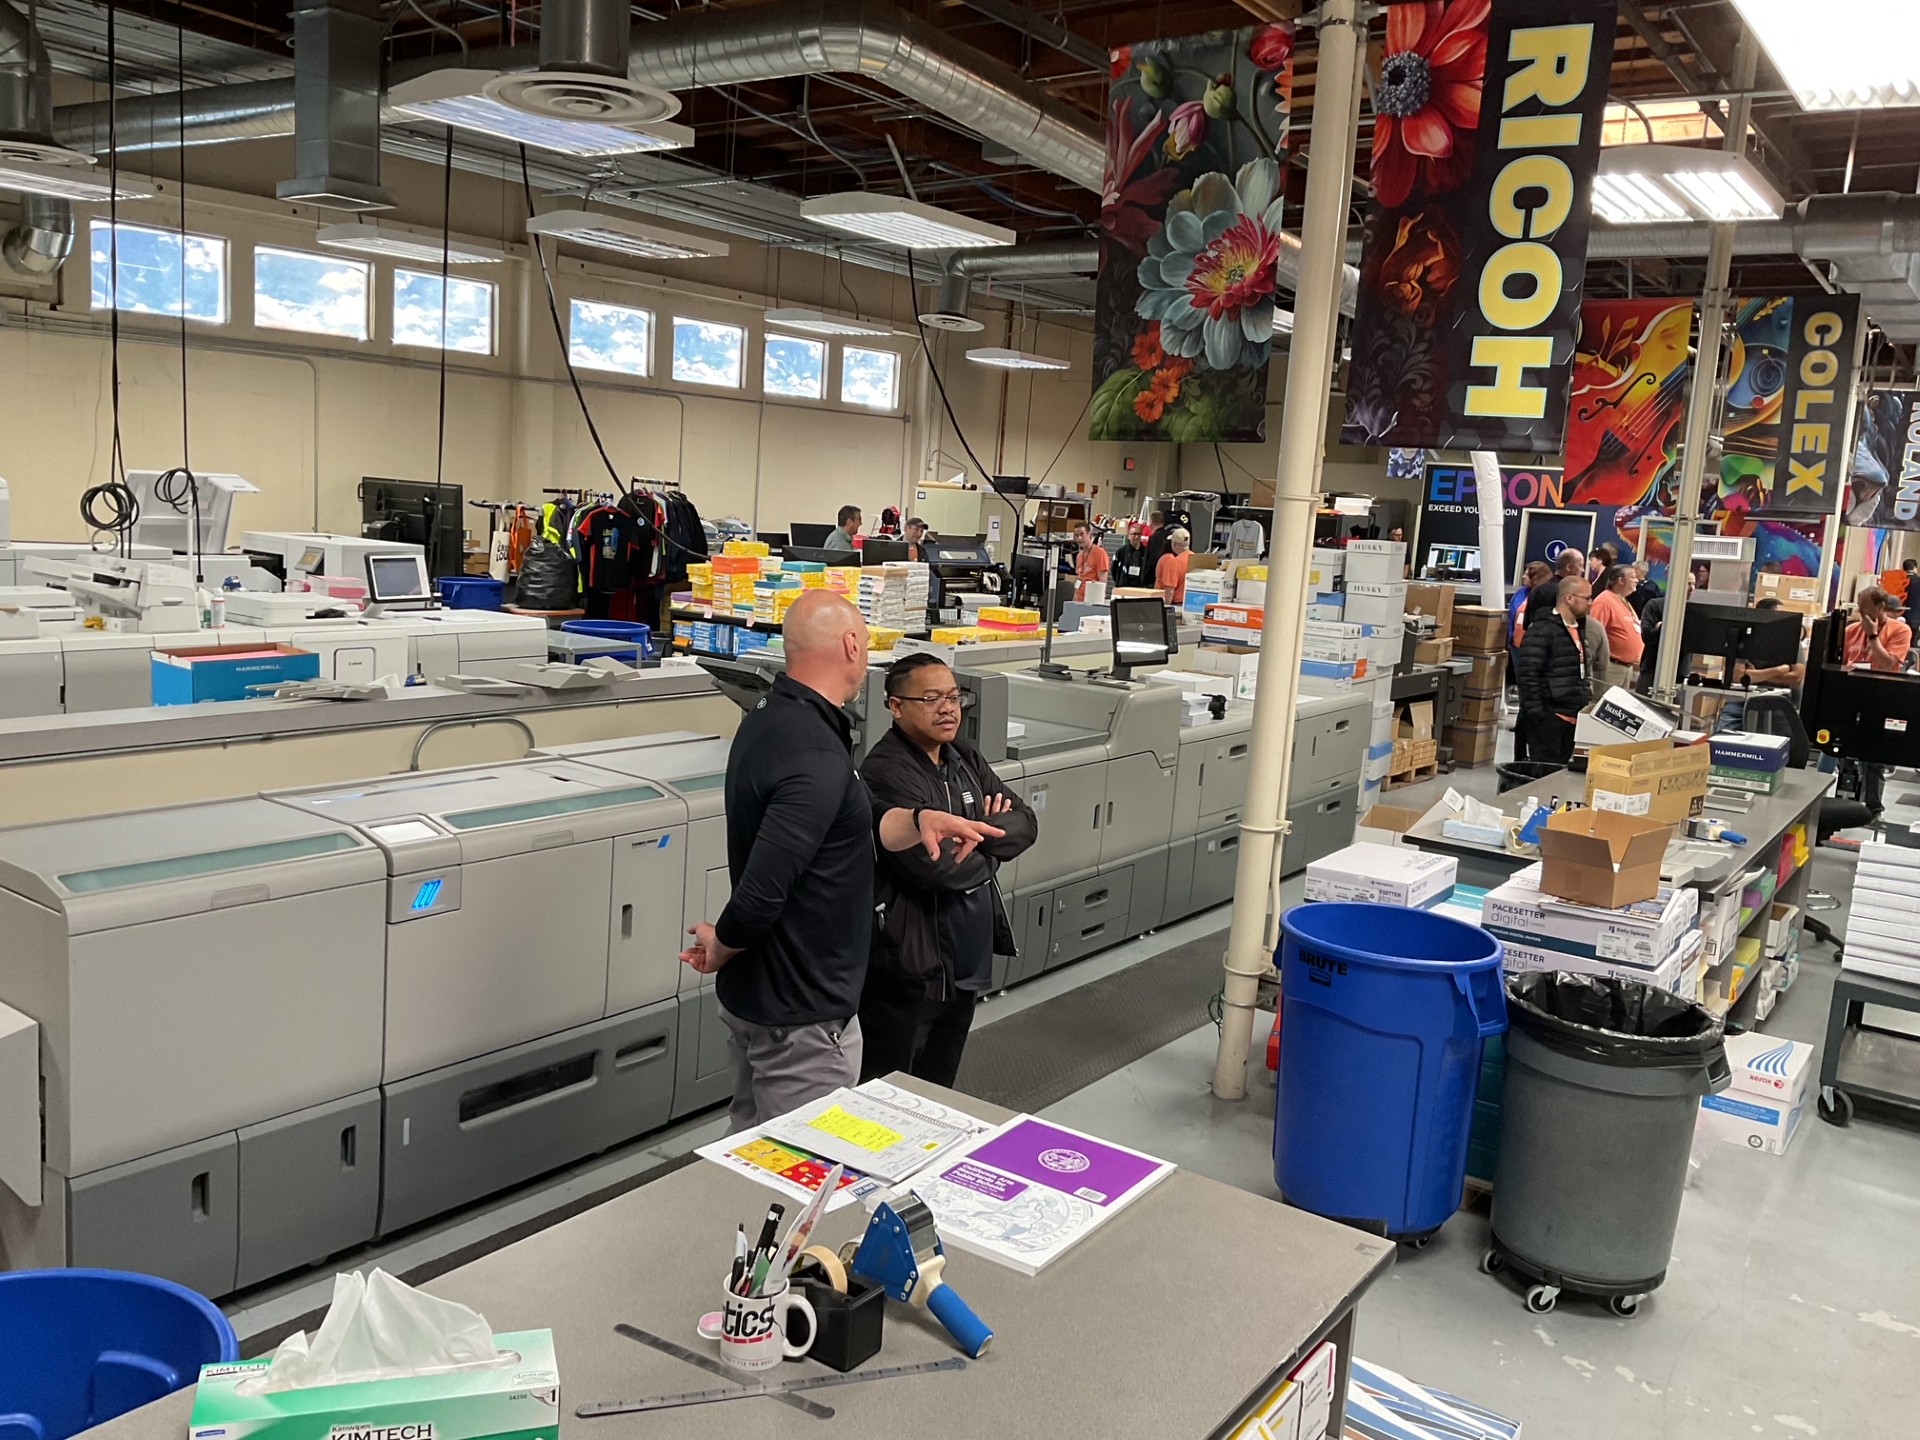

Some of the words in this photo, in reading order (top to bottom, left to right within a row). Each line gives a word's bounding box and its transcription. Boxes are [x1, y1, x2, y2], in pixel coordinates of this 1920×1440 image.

[1463, 23, 1594, 418] RICOH
[1786, 311, 1843, 497] COLEX
[1428, 503, 1462, 513] EXCEED
[1463, 505, 1480, 514] YOU
[1354, 543, 1384, 551] HUSKY
[1354, 585, 1382, 593] HUSKY
[236, 664, 282, 672] HAMMERMILL
[1604, 703, 1628, 720] husky
[1714, 749, 1764, 761] HAMMERMILL
[1379, 889, 1402, 898] ESETTER
[1492, 903, 1546, 919] PACESETTER
[1491, 912, 1529, 927] digital
[1503, 948, 1545, 963] CESETTER
[1299, 948, 1348, 976] BRUTE
[1503, 958, 1528, 970] gital
[1749, 1075, 1772, 1084] xerox
[723, 1300, 775, 1337] tics
[206, 1363, 267, 1375] KIMTECH
[331, 1424, 371, 1433] Kimwipes
[332, 1423, 432, 1440] KIMTECH
